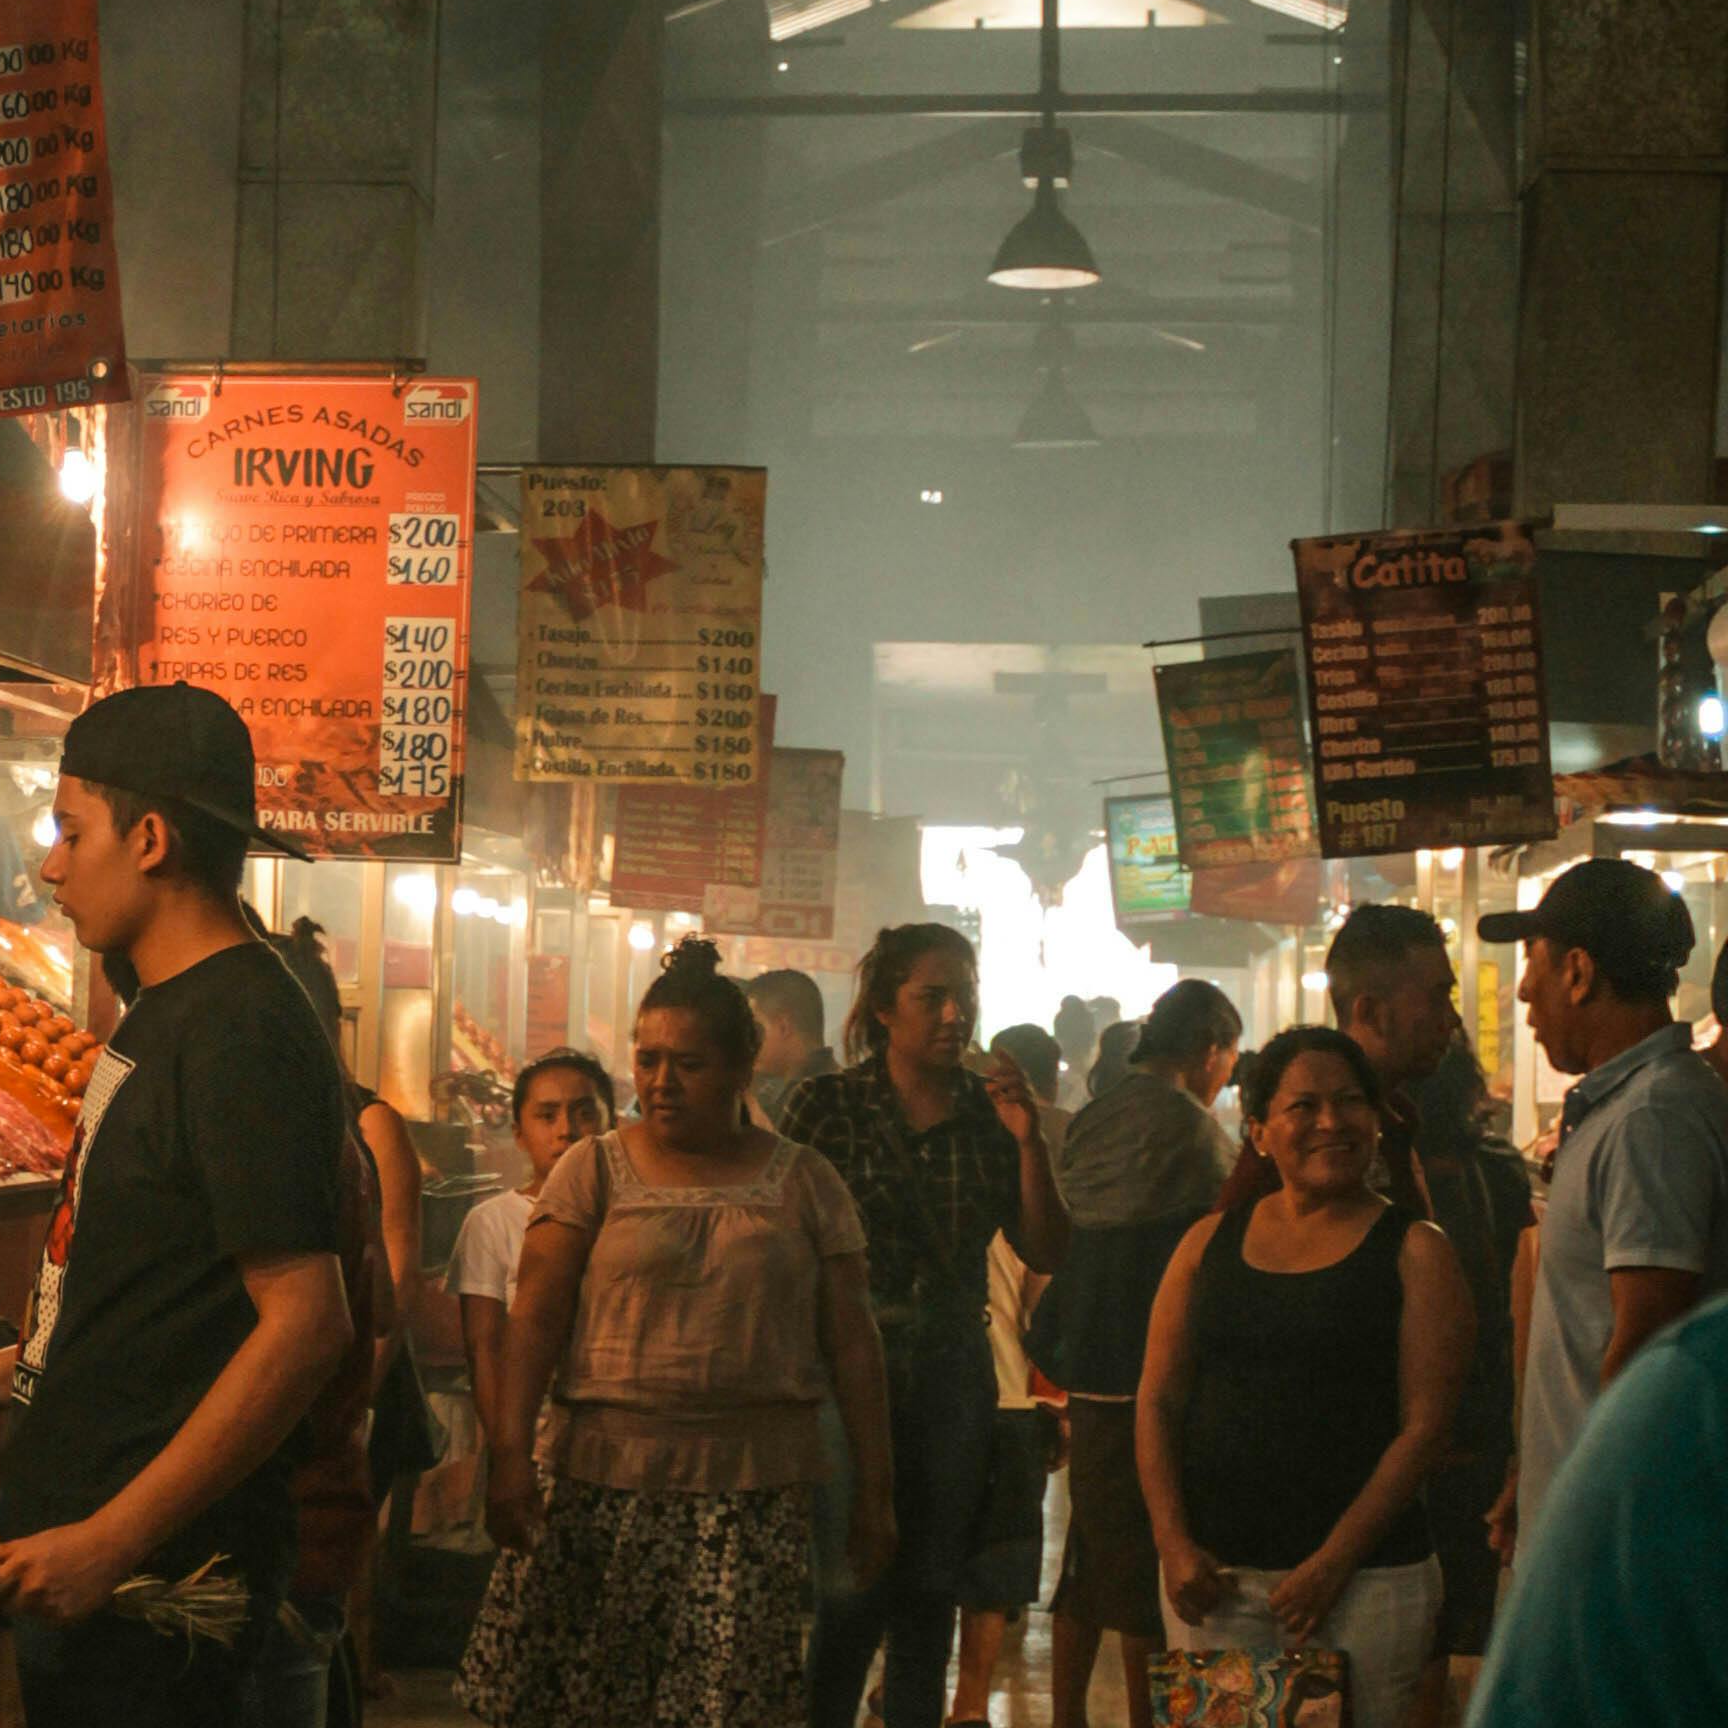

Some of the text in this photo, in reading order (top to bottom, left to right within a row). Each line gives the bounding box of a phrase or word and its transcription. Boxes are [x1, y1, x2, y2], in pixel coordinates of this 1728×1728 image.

[61, 38, 90, 63] Kg
[63, 83, 92, 108] Kg
[63, 127, 95, 153] Kg
[65, 174, 98, 198] Kg
[67, 219, 102, 245] Kg
[69, 266, 105, 292] Kg
[54, 379, 91, 403] 195
[405, 395, 463, 420] sandi
[186, 403, 426, 469] CARNES ASADAS
[232, 446, 375, 490] IRVING
[542, 499, 587, 518] 203
[248, 524, 276, 544] DE
[282, 524, 378, 544] PRIMERA
[1352, 551, 1467, 590] Catita
[251, 593, 278, 612] DE
[208, 627, 221, 646] Y
[226, 628, 308, 647] PUERCO
[696, 628, 755, 648] $200
[234, 663, 262, 681] DE
[696, 655, 754, 674] $140
[695, 708, 752, 729] $200
[257, 809, 435, 834] PARA SERVIRLE
[1326, 797, 1406, 824] Puesto
